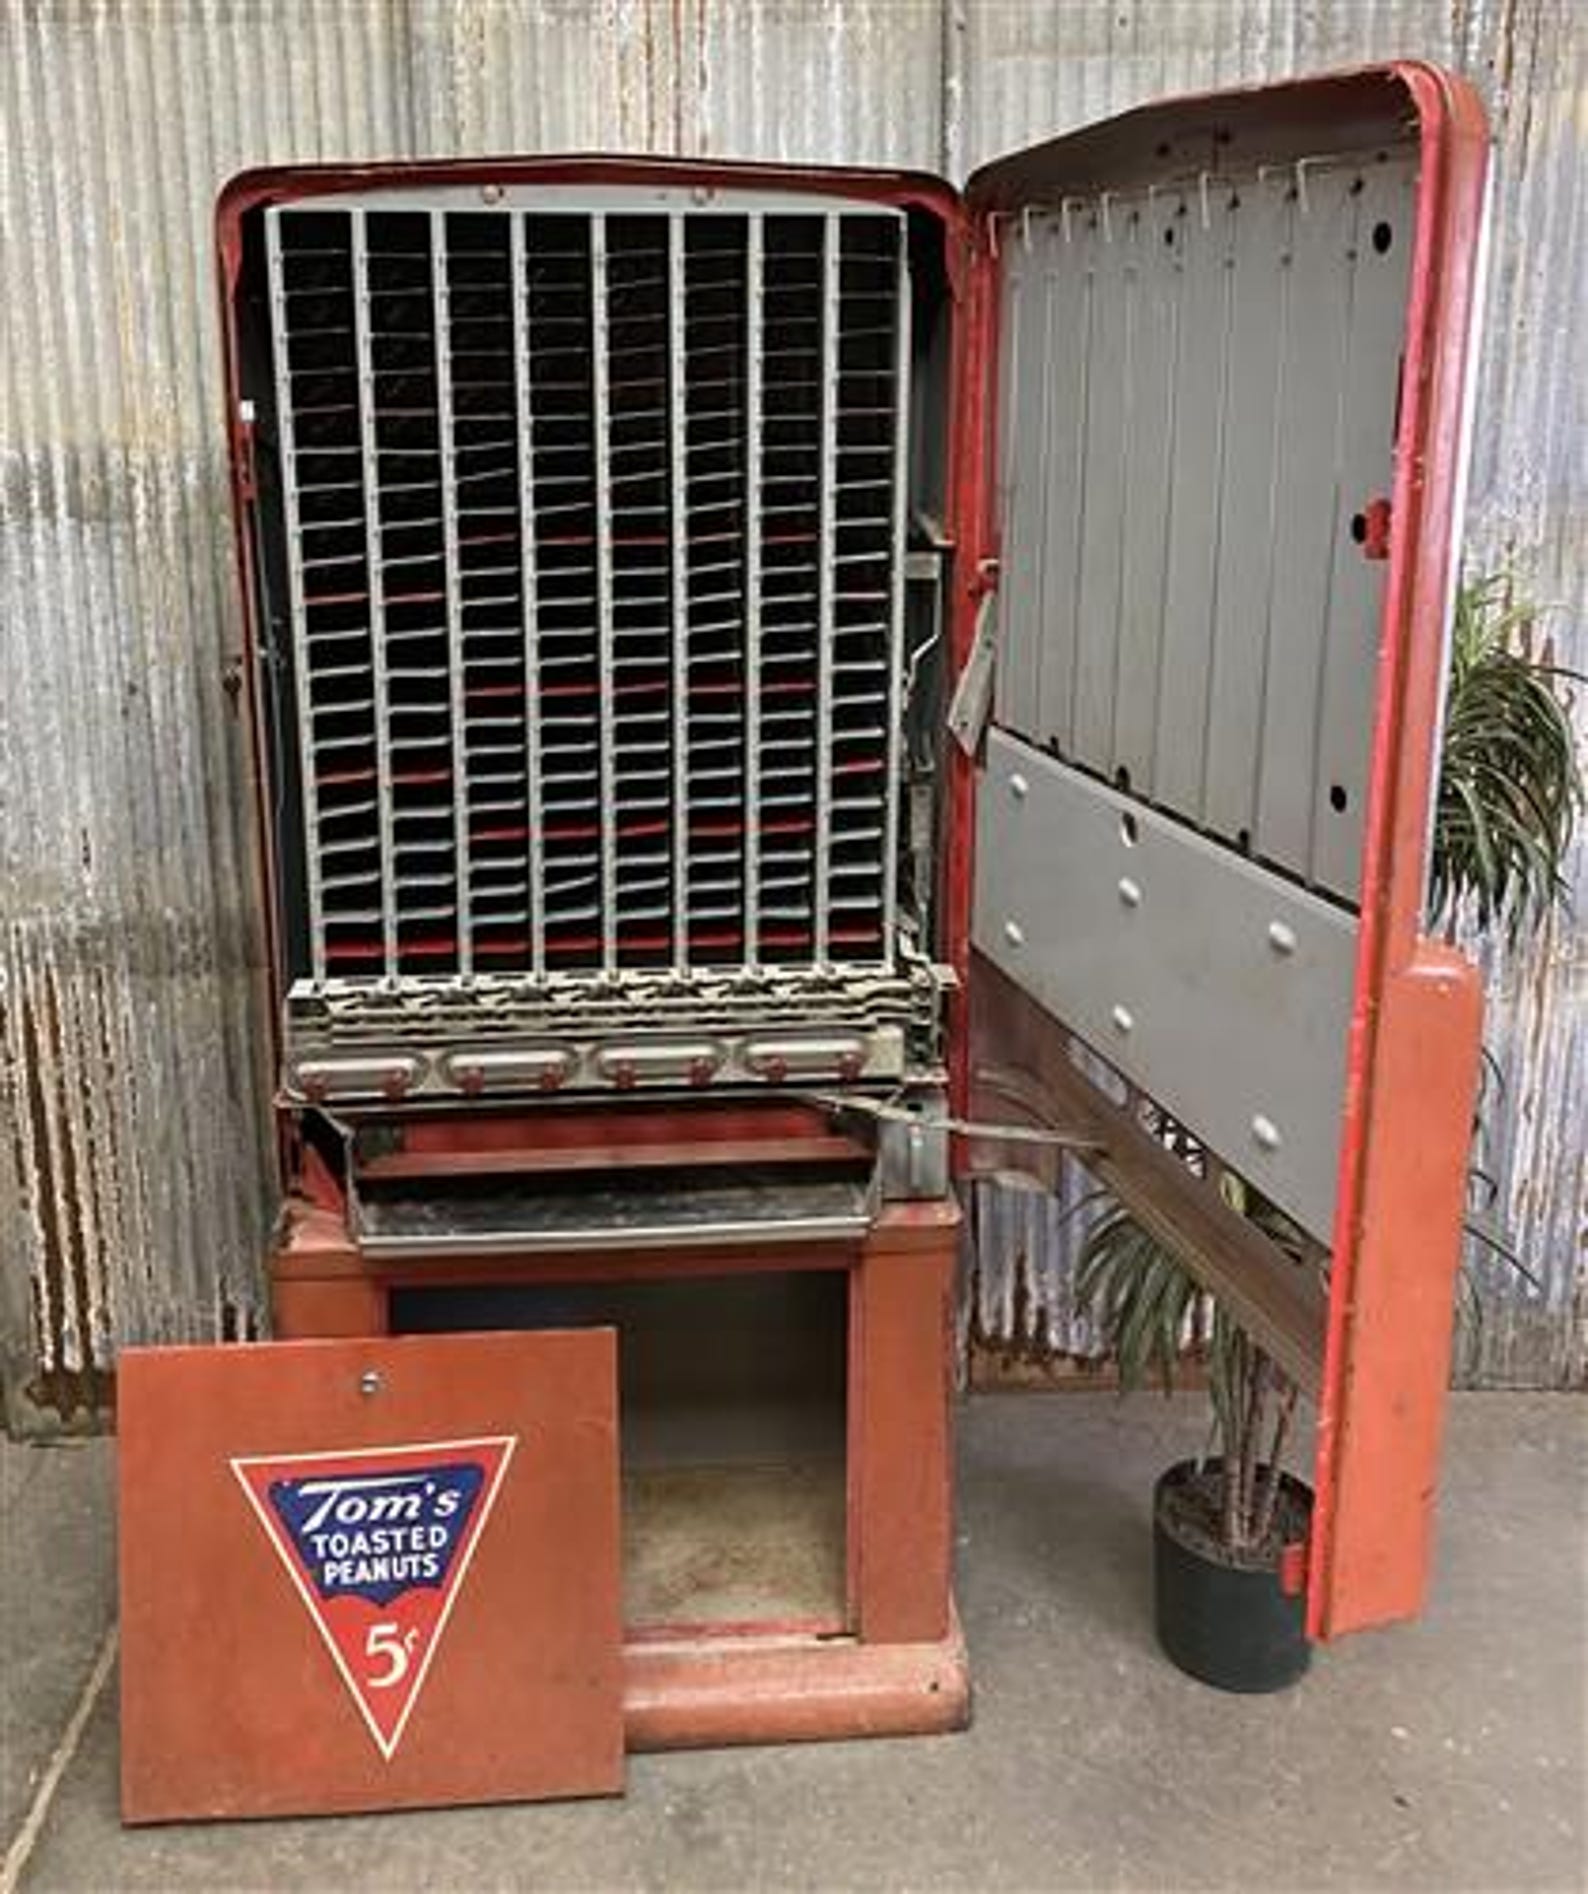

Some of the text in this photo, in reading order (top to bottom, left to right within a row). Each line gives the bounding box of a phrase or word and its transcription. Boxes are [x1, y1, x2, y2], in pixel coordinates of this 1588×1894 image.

[298, 1475, 461, 1533] Tom's
[311, 1525, 448, 1558] TOASTED
[324, 1553, 440, 1586] PEANUTS
